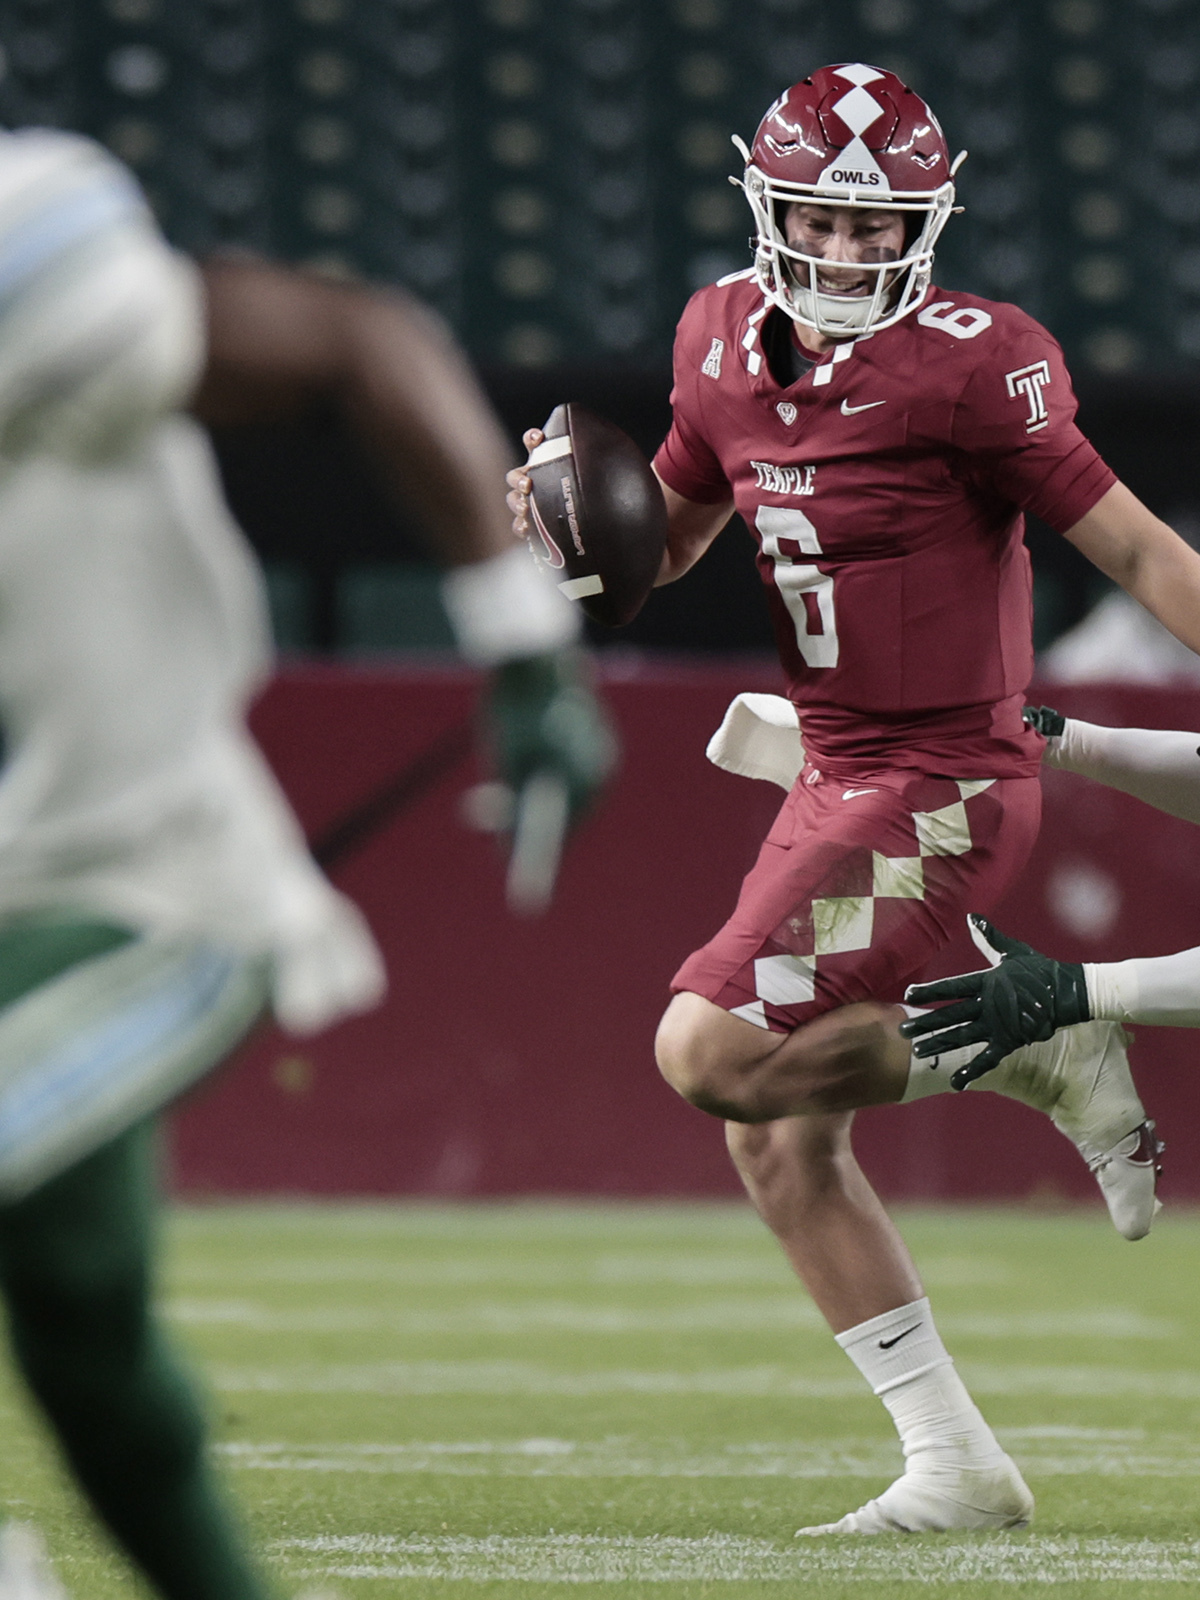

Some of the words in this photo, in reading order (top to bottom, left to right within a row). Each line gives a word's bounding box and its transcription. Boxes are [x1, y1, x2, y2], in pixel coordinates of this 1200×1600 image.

[831, 170, 880, 186] OWLS
[917, 301, 993, 340] 6
[1005, 360, 1051, 434] T
[750, 460, 816, 496] TEMPLE
[755, 505, 839, 668] 6
